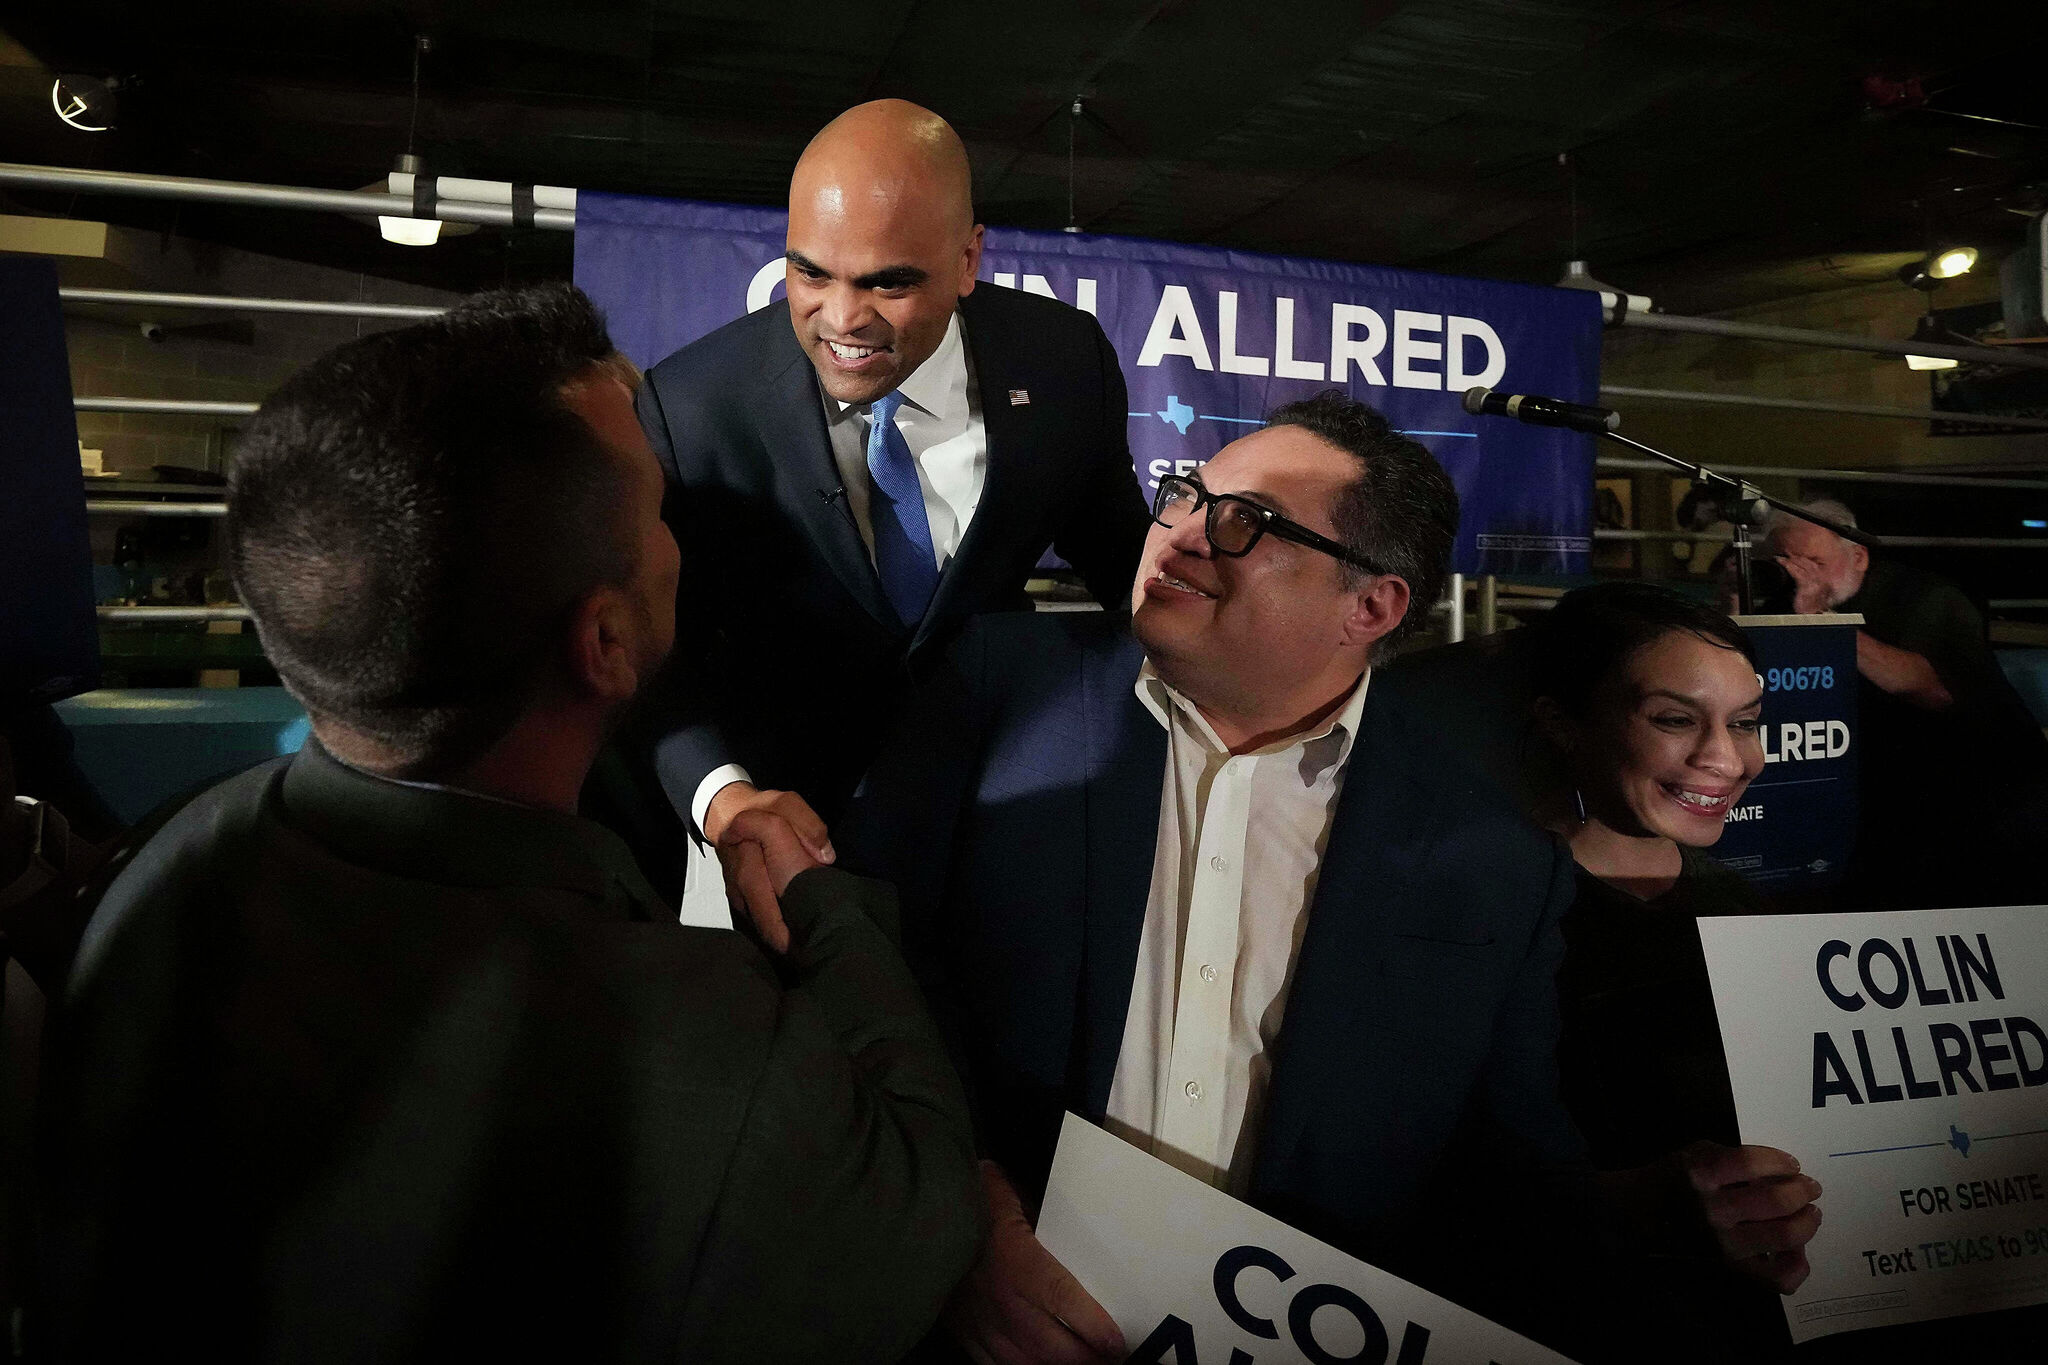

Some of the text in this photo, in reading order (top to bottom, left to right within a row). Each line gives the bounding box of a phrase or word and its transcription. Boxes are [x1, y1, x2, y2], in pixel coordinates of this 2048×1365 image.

[1137, 285, 1507, 391] ALLRED
[1768, 665, 1834, 692] 90678
[1760, 719, 1850, 764] LRED
[1816, 933, 2005, 1012] COLIN
[1812, 1016, 2048, 1108] ALLRED
[1900, 1174, 2045, 1217] FOR SENATE
[1862, 1246, 1917, 1277] Text
[1919, 1236, 1994, 1269] TEXAS
[1997, 1235, 2021, 1259] to
